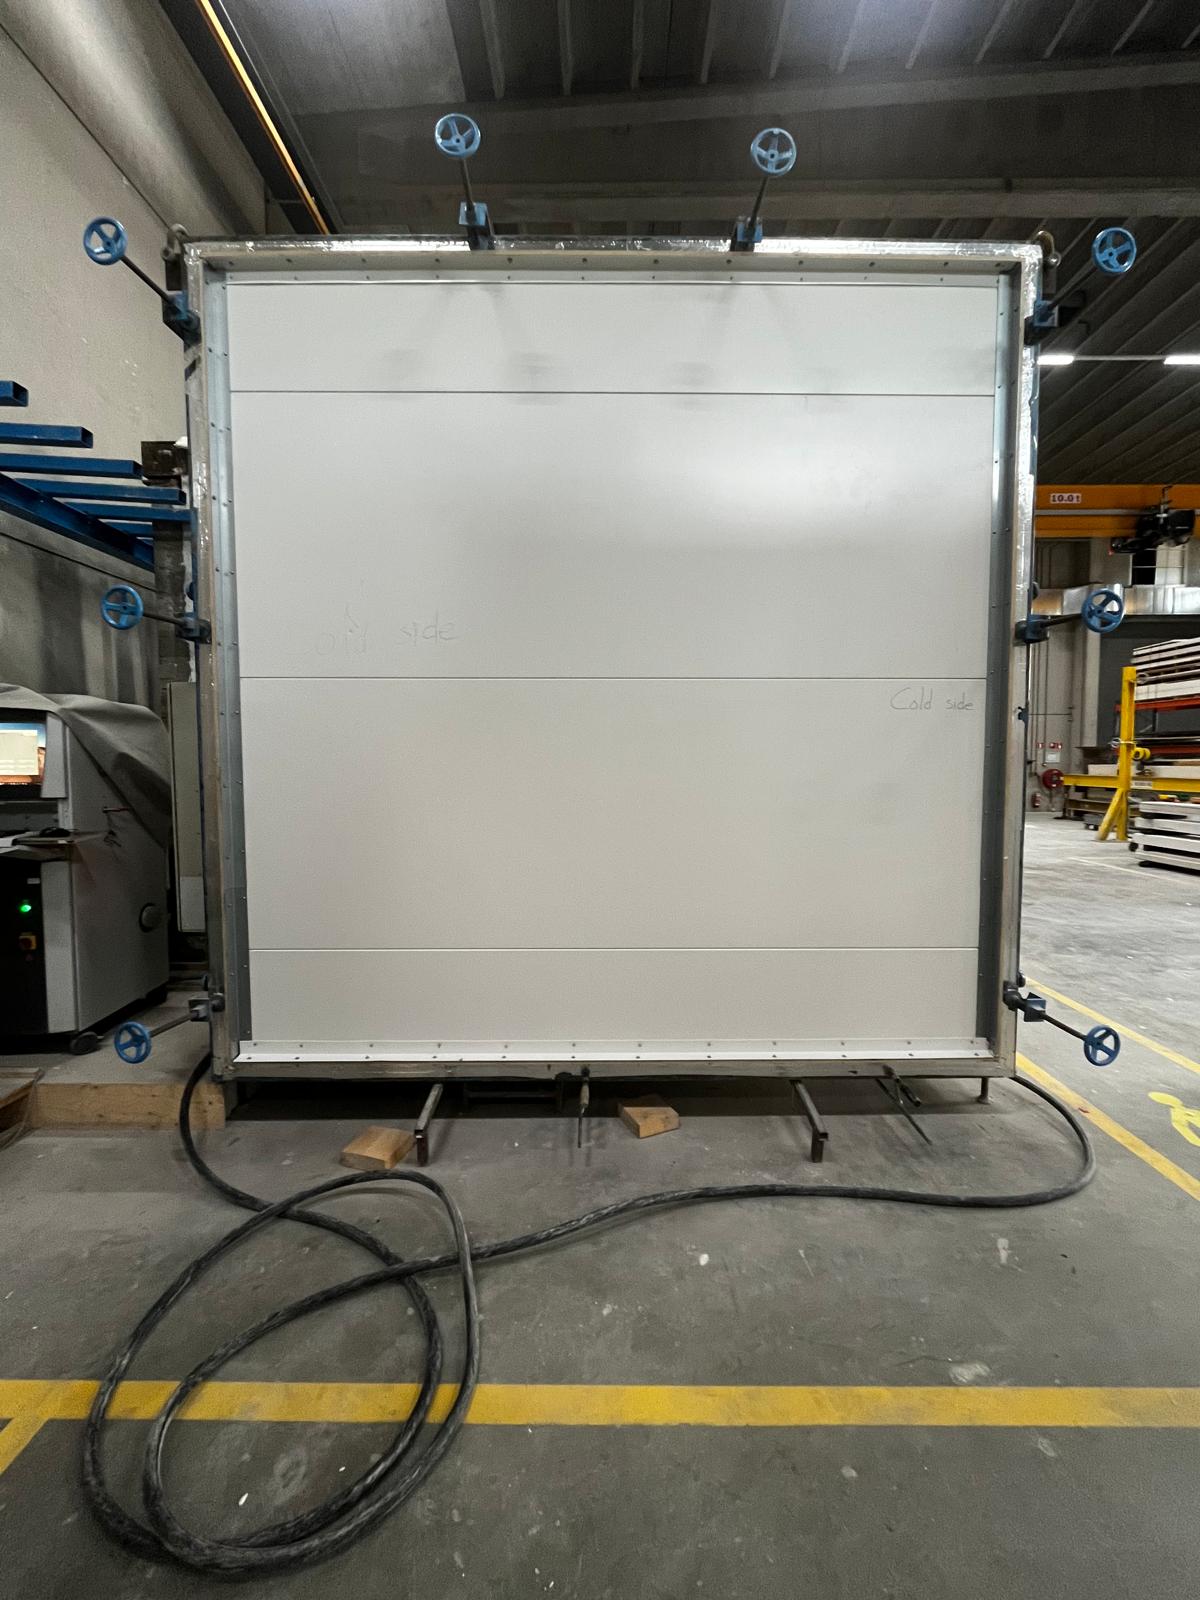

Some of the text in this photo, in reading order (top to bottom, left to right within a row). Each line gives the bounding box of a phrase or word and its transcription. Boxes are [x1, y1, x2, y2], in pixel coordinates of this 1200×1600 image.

[396, 609, 461, 647] side
[890, 686, 977, 711] Cold side
